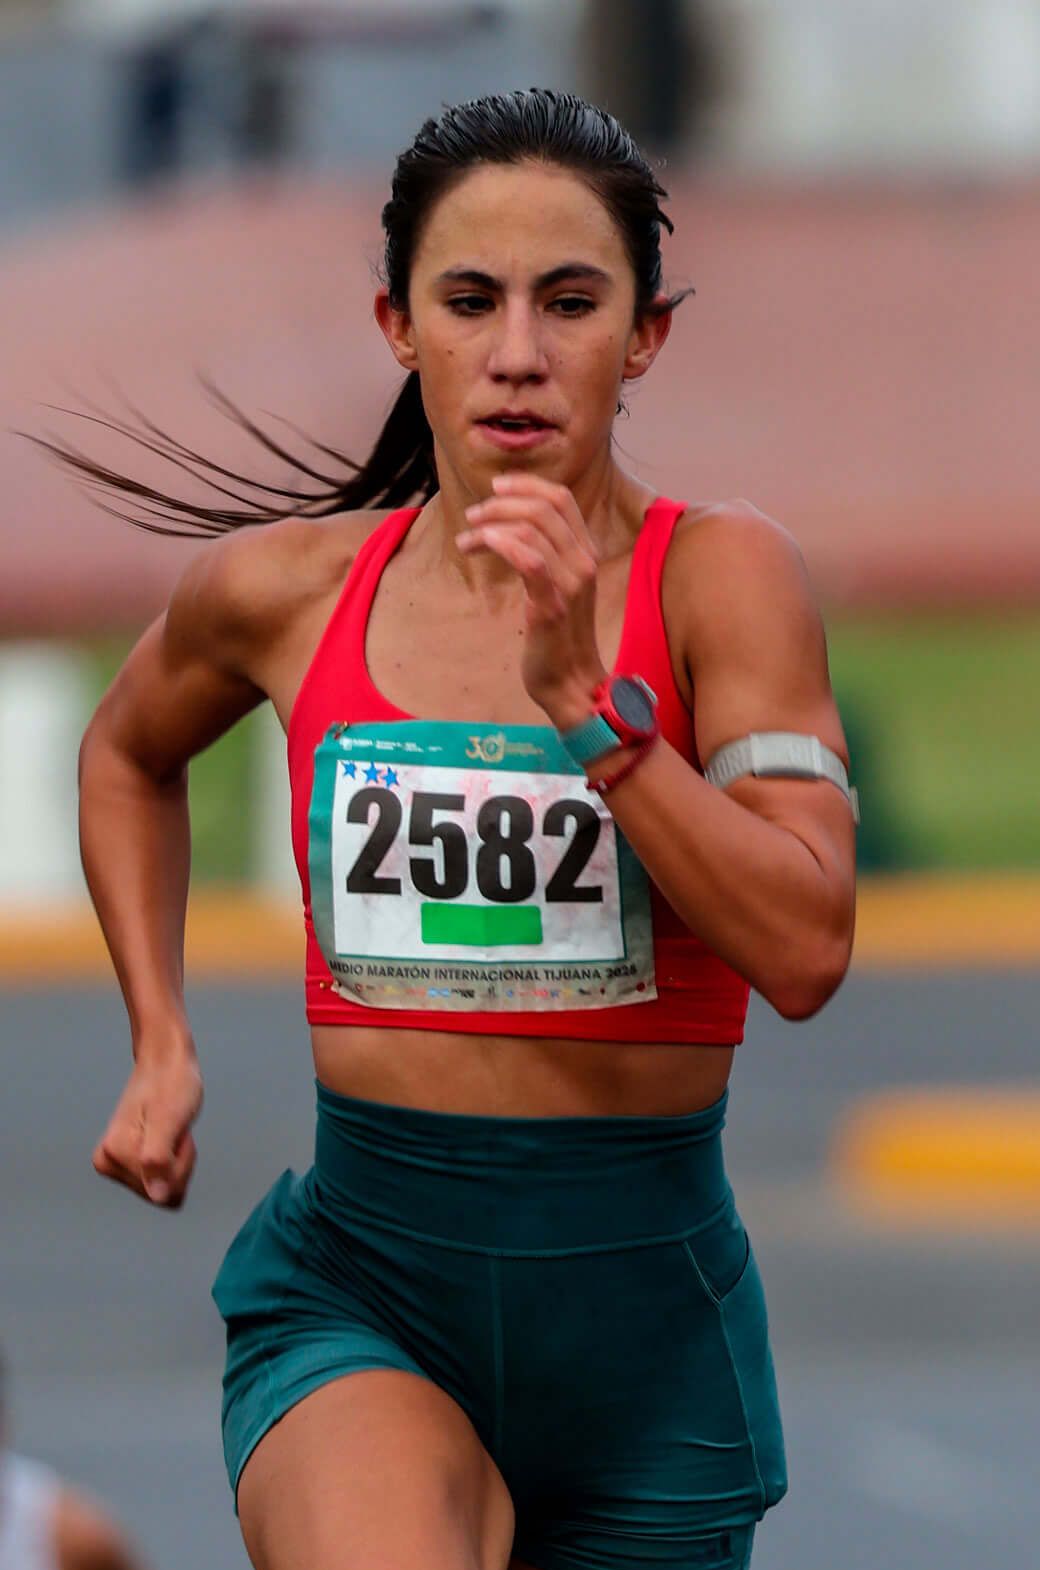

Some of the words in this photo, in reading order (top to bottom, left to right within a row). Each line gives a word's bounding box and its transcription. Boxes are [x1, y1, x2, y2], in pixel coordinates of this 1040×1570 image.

[346, 786, 604, 903] 2582
[329, 960, 363, 976] MEDIO
[367, 964, 430, 979] MARATÓN
[435, 967, 540, 981] INTERNACIONAL
[544, 967, 602, 981] TIJUANA
